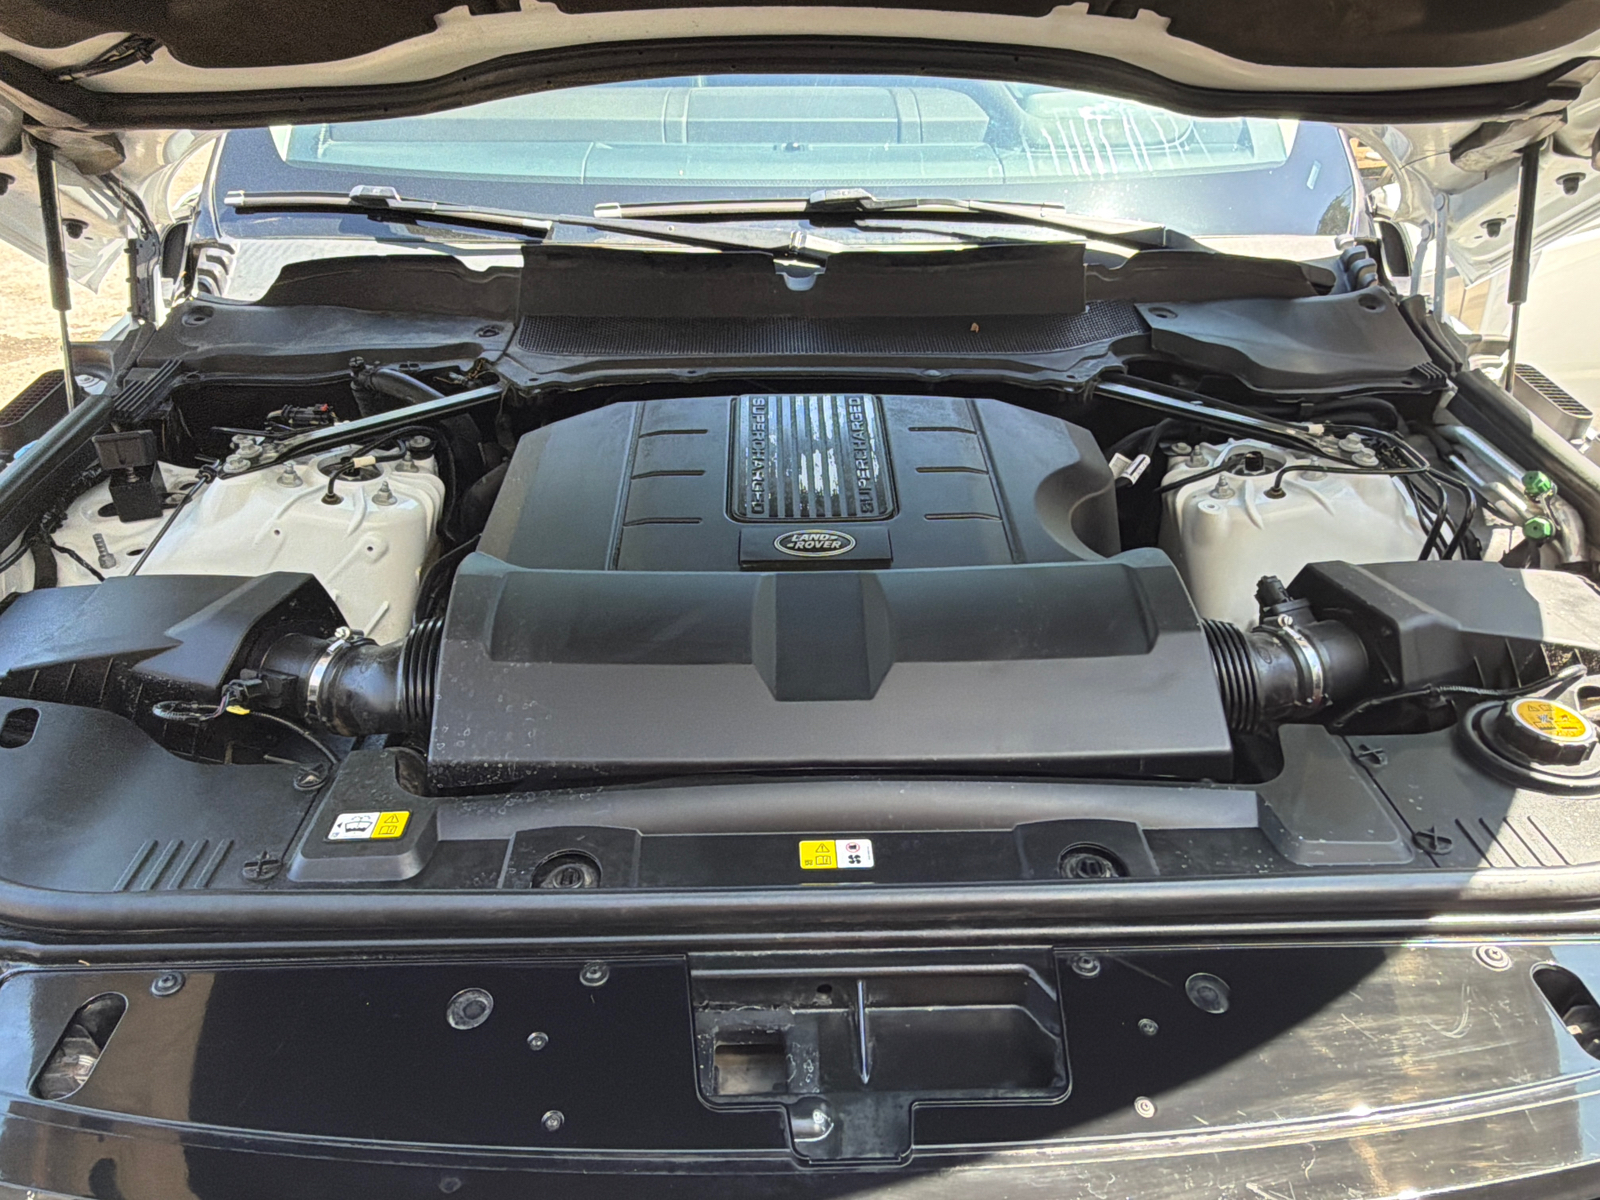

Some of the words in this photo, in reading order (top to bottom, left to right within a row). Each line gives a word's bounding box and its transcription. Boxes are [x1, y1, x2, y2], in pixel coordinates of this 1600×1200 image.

[752, 398, 765, 514] SUPERCHARGED
[849, 397, 874, 514] SUPERCHARGED
[791, 533, 829, 542] LAND
[794, 540, 842, 549] ROVER
